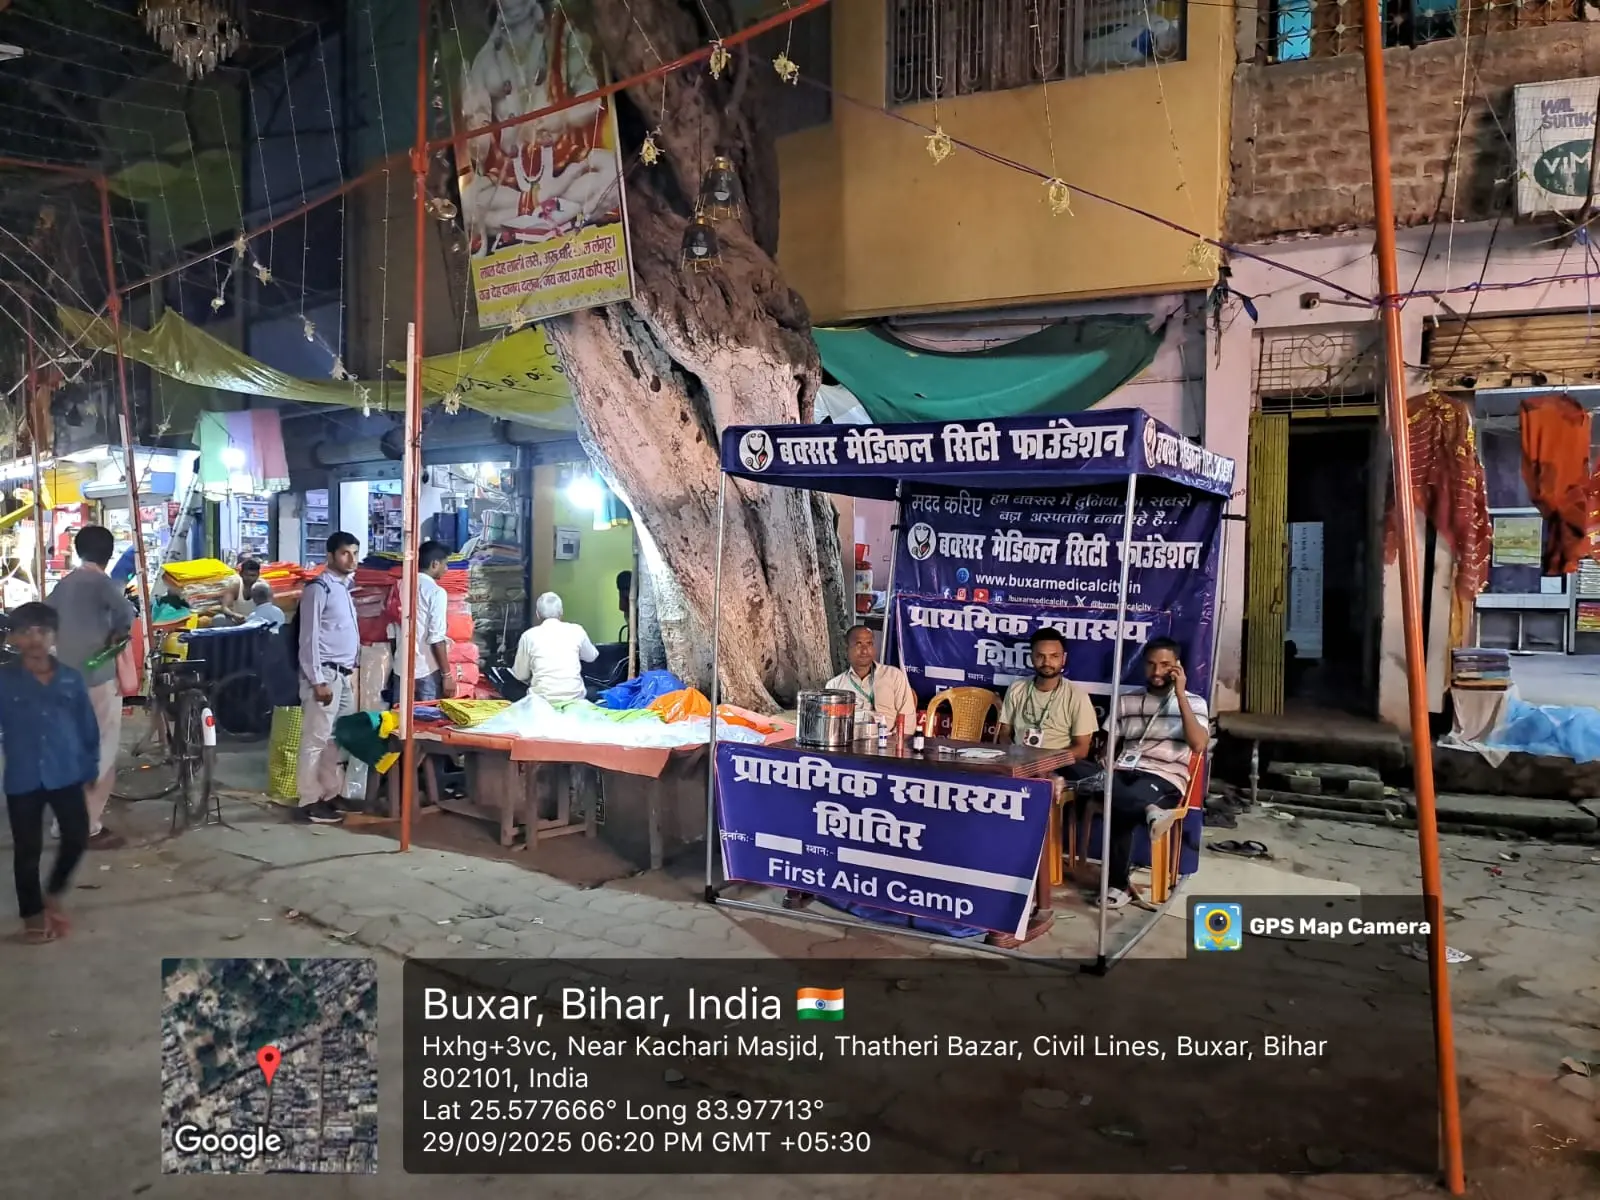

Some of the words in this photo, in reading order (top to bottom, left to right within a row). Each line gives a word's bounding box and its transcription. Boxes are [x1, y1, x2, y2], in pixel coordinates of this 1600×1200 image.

[1543, 151, 1592, 174] VIM
[776, 436, 838, 465] बक्सर
[844, 428, 934, 465] मेडिकल
[941, 422, 1001, 463] सिटी
[1009, 418, 1129, 460] फाउंडेशन
[912, 494, 940, 513] मदद
[944, 489, 983, 517] करिए
[990, 494, 1010, 506] हम
[1030, 512, 1091, 525] अस्पताल
[1093, 514, 1125, 525] बना
[937, 532, 987, 560] बक्सर
[991, 529, 1060, 565] मेडिकल
[1065, 532, 1110, 568] सिटी
[1116, 533, 1203, 569] फाउंडेशन
[812, 801, 926, 850] शिविर
[768, 857, 826, 888] First
[832, 870, 878, 897] Aid
[887, 880, 974, 919] Camp
